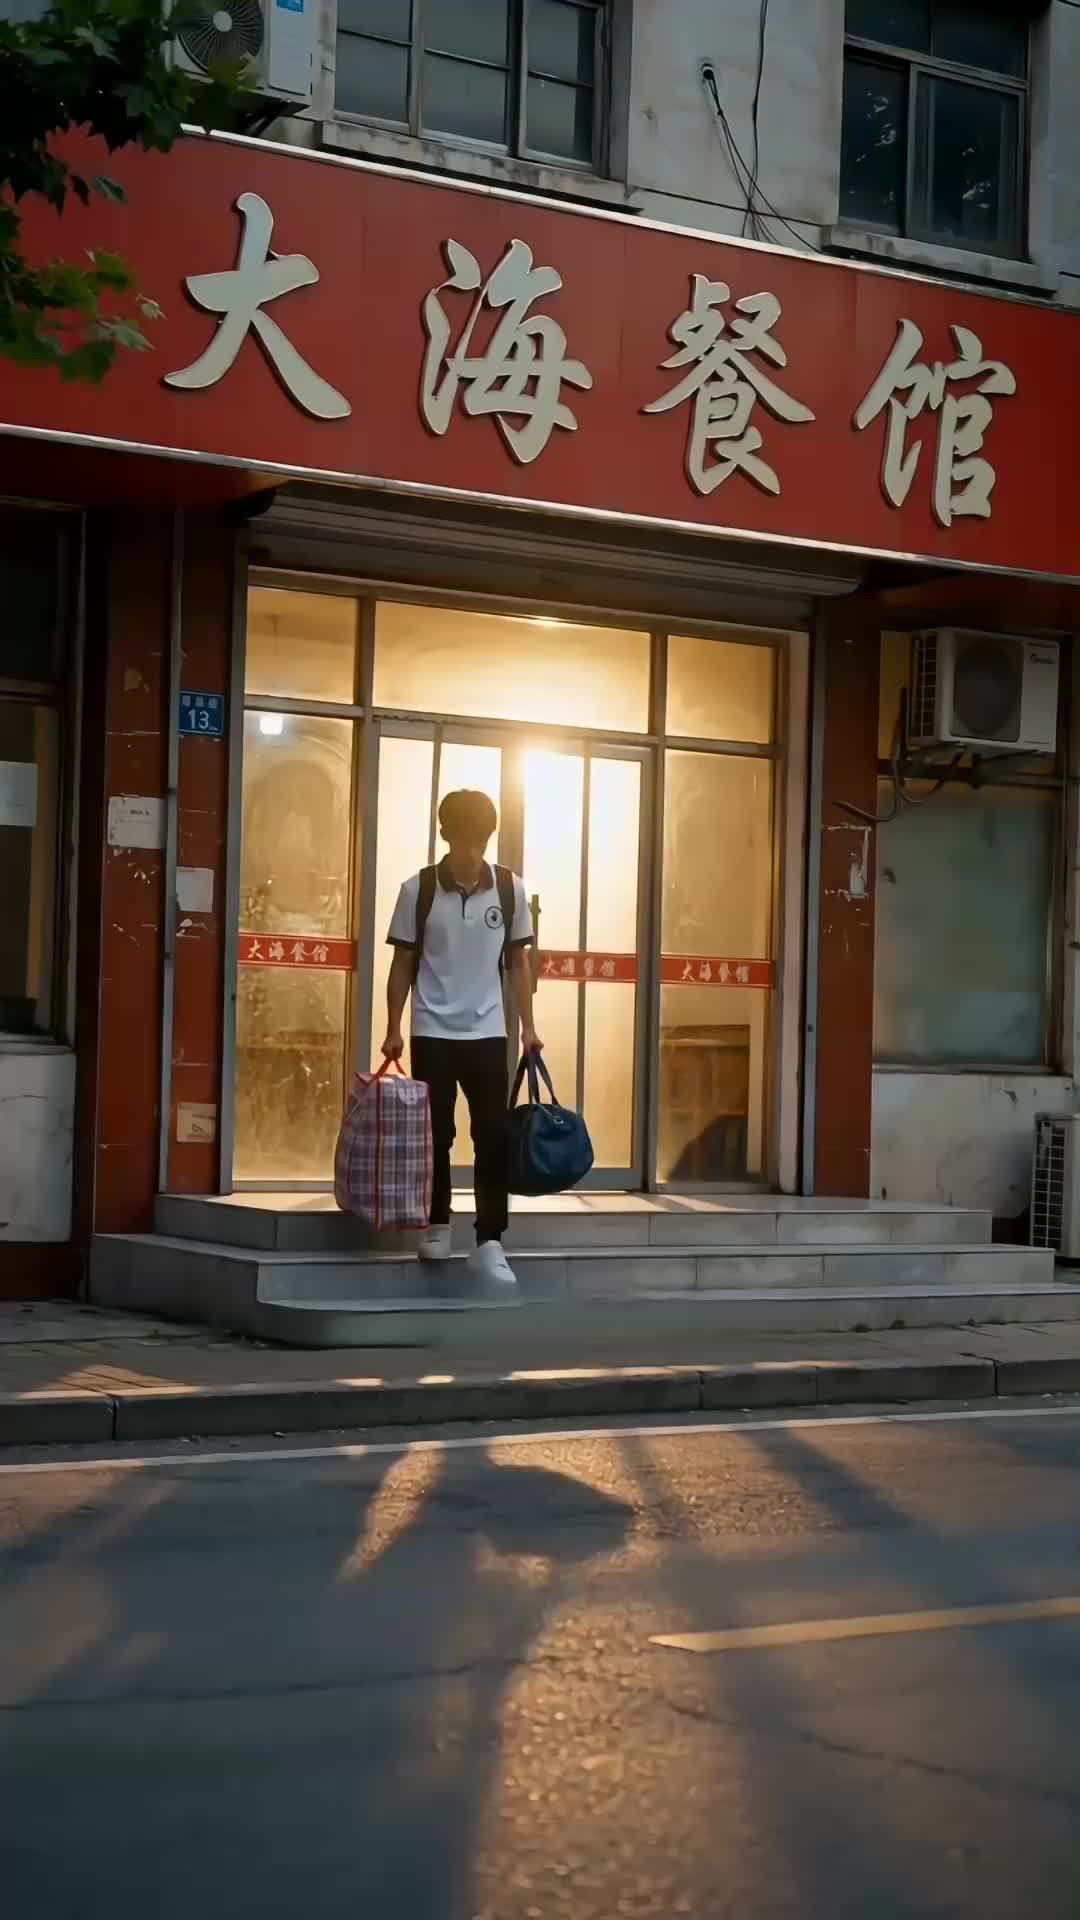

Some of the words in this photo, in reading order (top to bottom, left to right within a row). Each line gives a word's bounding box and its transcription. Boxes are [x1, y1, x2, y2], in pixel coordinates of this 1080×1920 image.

[164, 191, 1017, 528] 大海餐馆
[188, 709, 209, 730] 13
